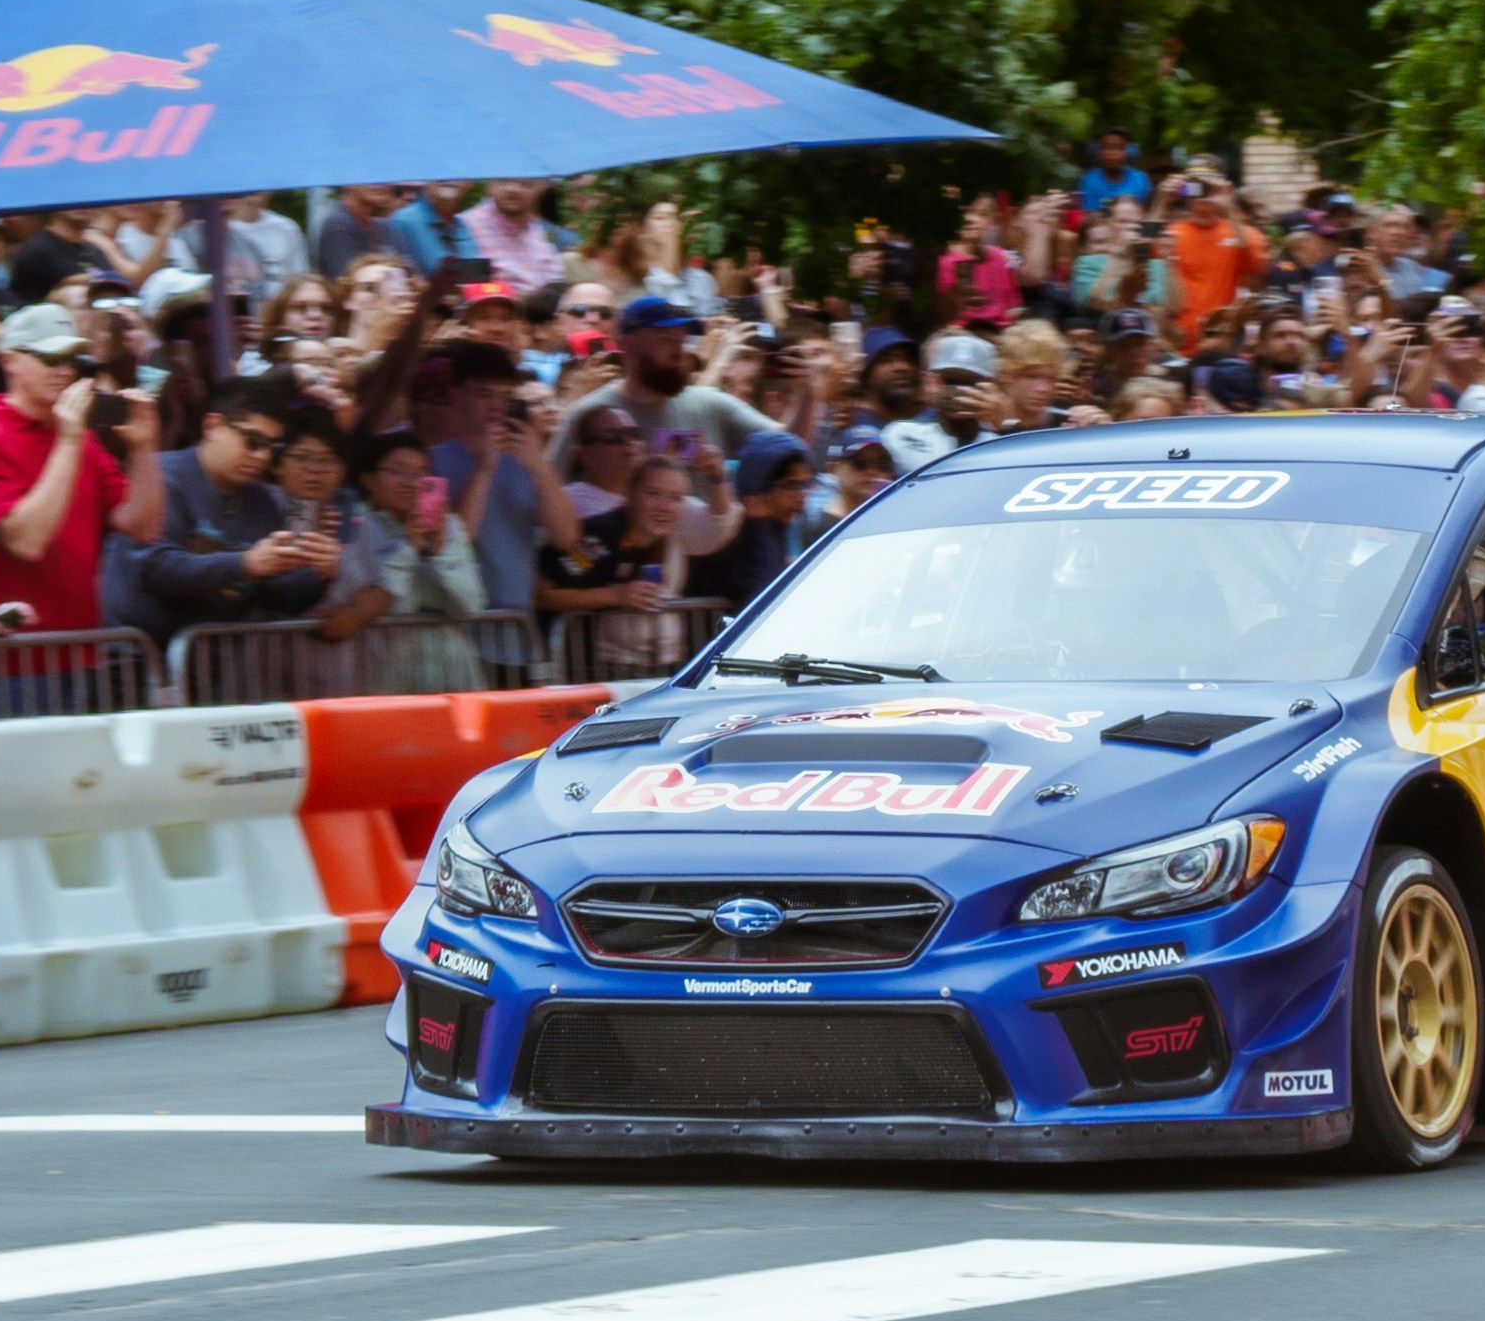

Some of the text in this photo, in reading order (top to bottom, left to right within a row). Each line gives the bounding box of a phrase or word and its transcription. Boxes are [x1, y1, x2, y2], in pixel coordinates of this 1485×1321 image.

[1006, 471, 1289, 511] SPEED
[593, 762, 1031, 816] Red Bull
[438, 947, 490, 982] YOKOHAMA
[1075, 946, 1185, 979] YOKOHAMA
[684, 977, 813, 996] VermontSportsCar
[1267, 1073, 1329, 1093] MOTUL
